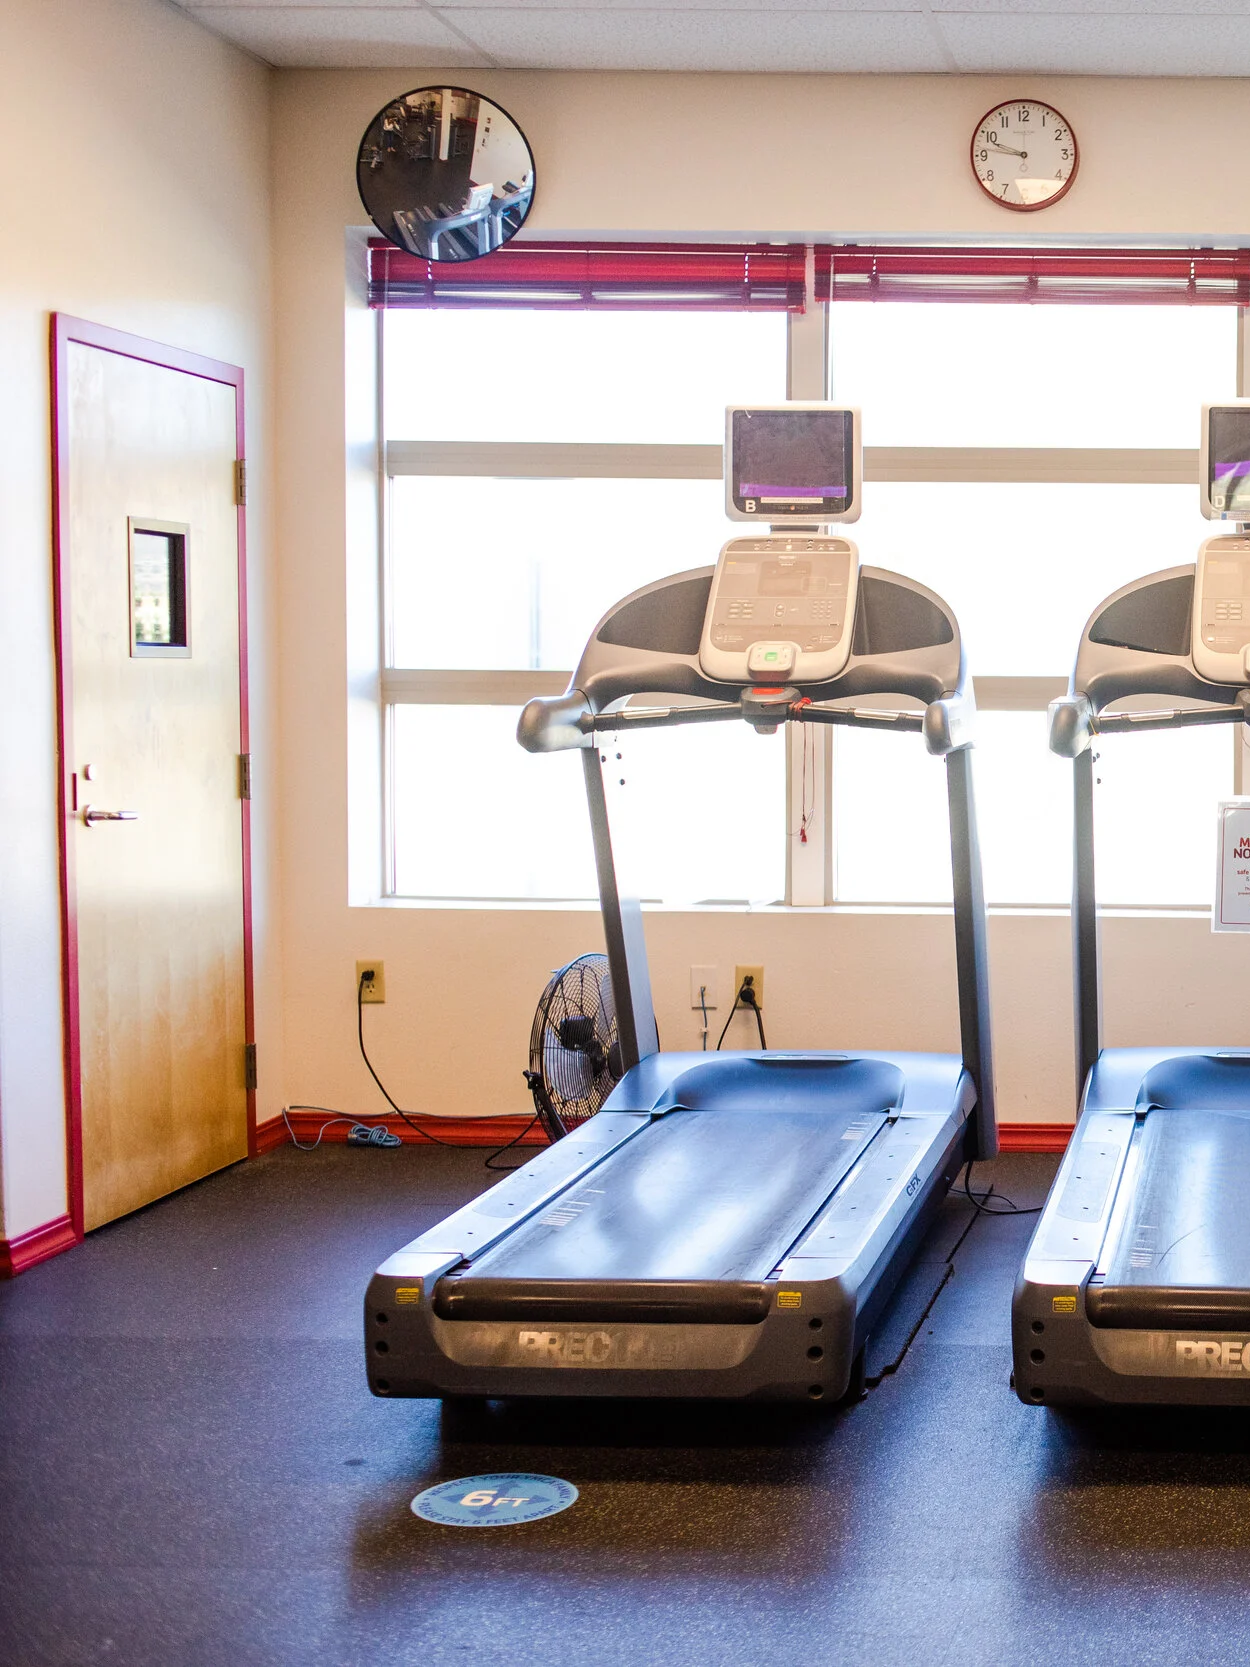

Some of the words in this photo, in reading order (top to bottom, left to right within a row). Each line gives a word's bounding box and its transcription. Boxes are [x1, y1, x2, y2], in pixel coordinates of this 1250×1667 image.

[1001, 116, 1009, 128] 11
[1018, 110, 1030, 122] 12
[1042, 115, 1045, 127] 1
[986, 131, 997, 143] 10
[1054, 129, 1062, 141] 2
[980, 150, 988, 161] 9
[1061, 149, 1069, 160] 3
[986, 170, 994, 181] 8
[1055, 169, 1062, 181] 4
[1001, 184, 1009, 195] 7
[745, 499, 756, 513] B
[1214, 496, 1225, 508] D
[906, 1173, 922, 1197] GFX
[437, 1515, 471, 1524] STAY
[486, 1516, 518, 1524] FEET
